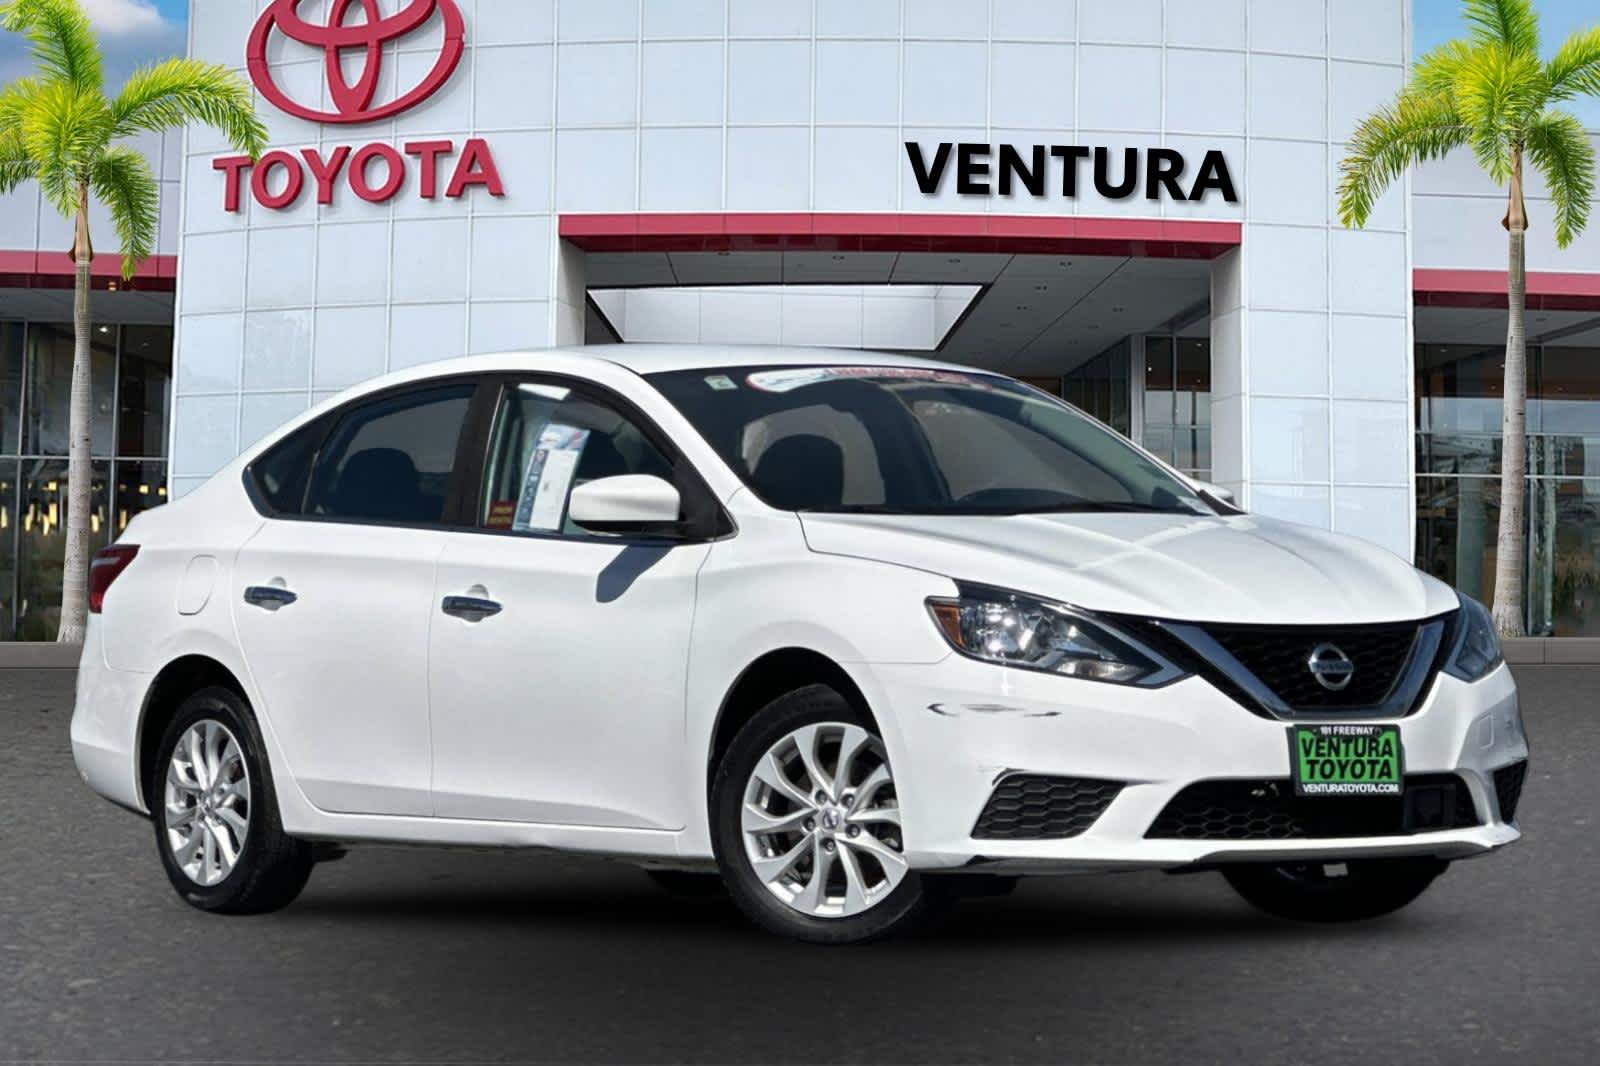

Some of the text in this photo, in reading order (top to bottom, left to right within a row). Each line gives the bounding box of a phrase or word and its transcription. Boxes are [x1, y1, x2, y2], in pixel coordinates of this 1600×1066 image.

[212, 138, 505, 213] TOYOTA
[904, 142, 1239, 203] VENTURA
[1333, 726, 1375, 736] FREEWAY
[1301, 736, 1393, 758] VENTURA
[1306, 759, 1393, 779] TOYOTA
[1302, 783, 1399, 793] VENTURATOYOTA.COM
